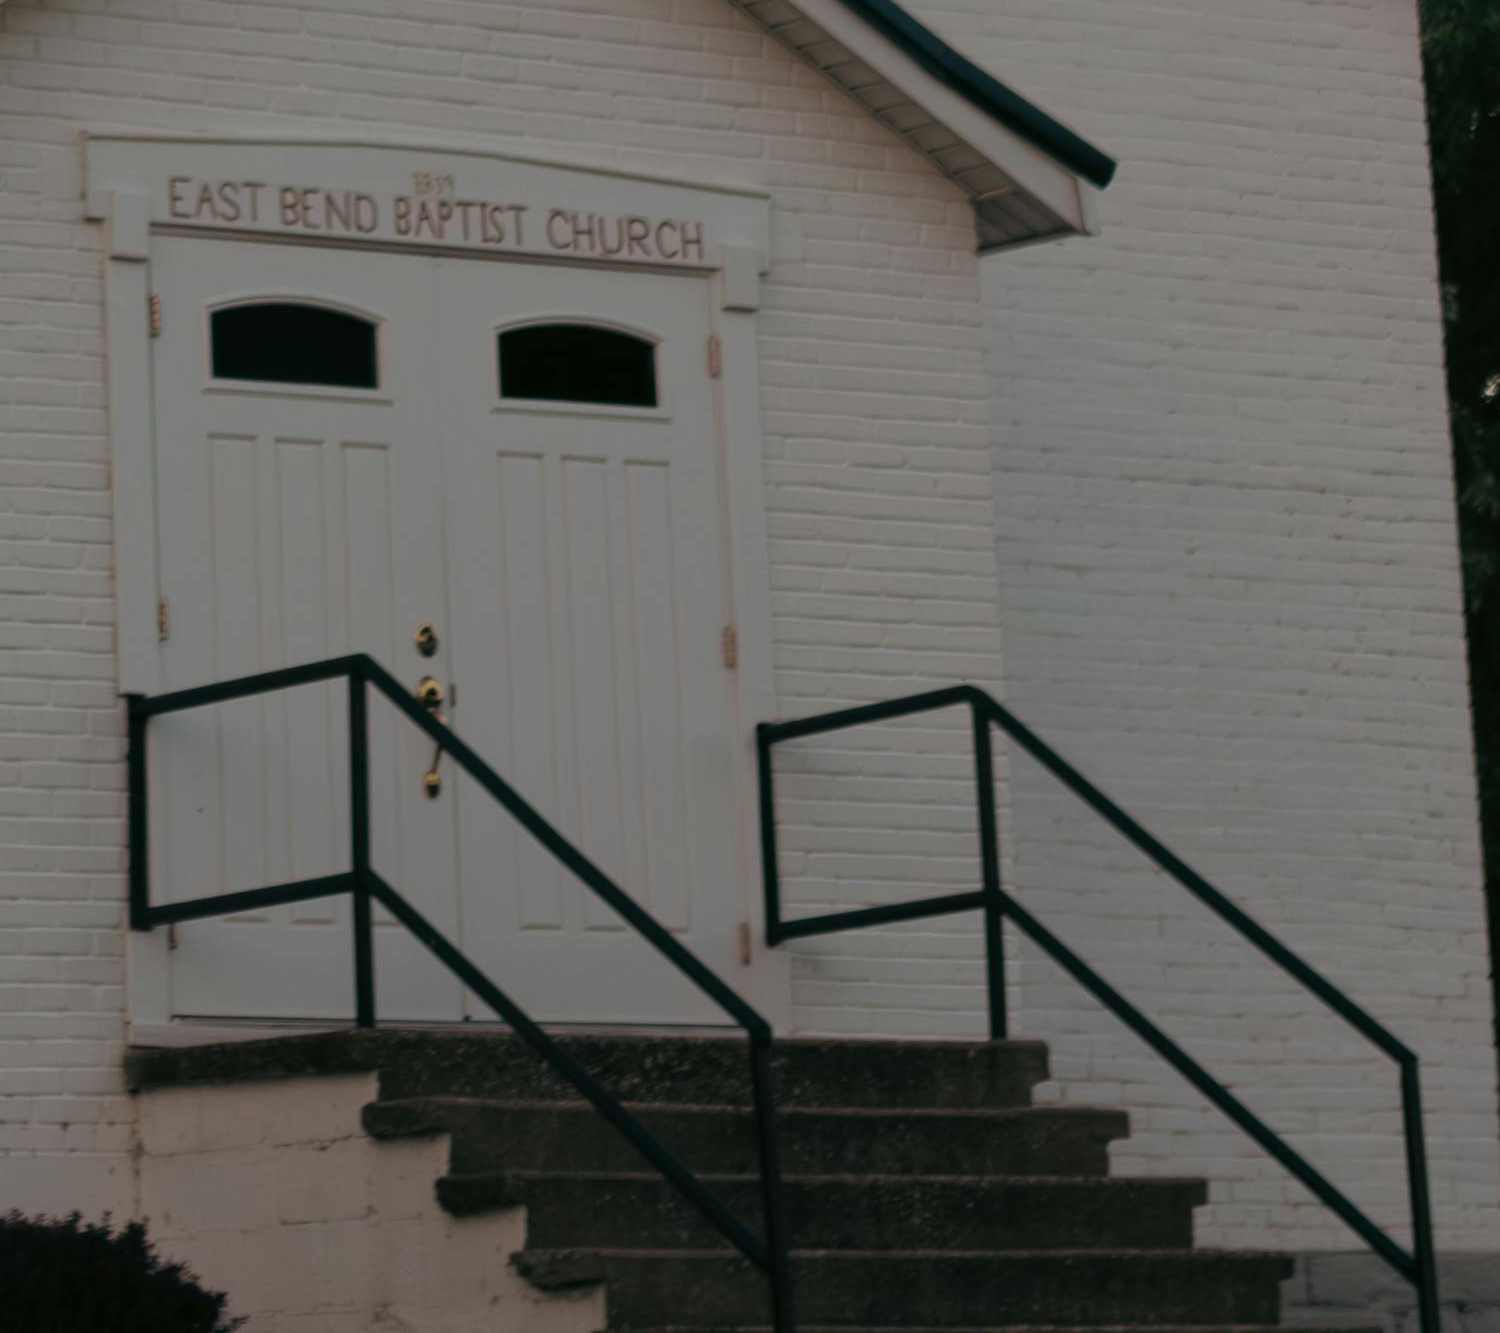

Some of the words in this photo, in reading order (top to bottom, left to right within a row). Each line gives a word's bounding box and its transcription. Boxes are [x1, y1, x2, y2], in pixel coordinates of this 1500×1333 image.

[167, 176, 267, 222] EAST
[280, 186, 378, 234] BEND
[394, 196, 529, 247] BAPTIST
[546, 208, 705, 261] CHURCH
